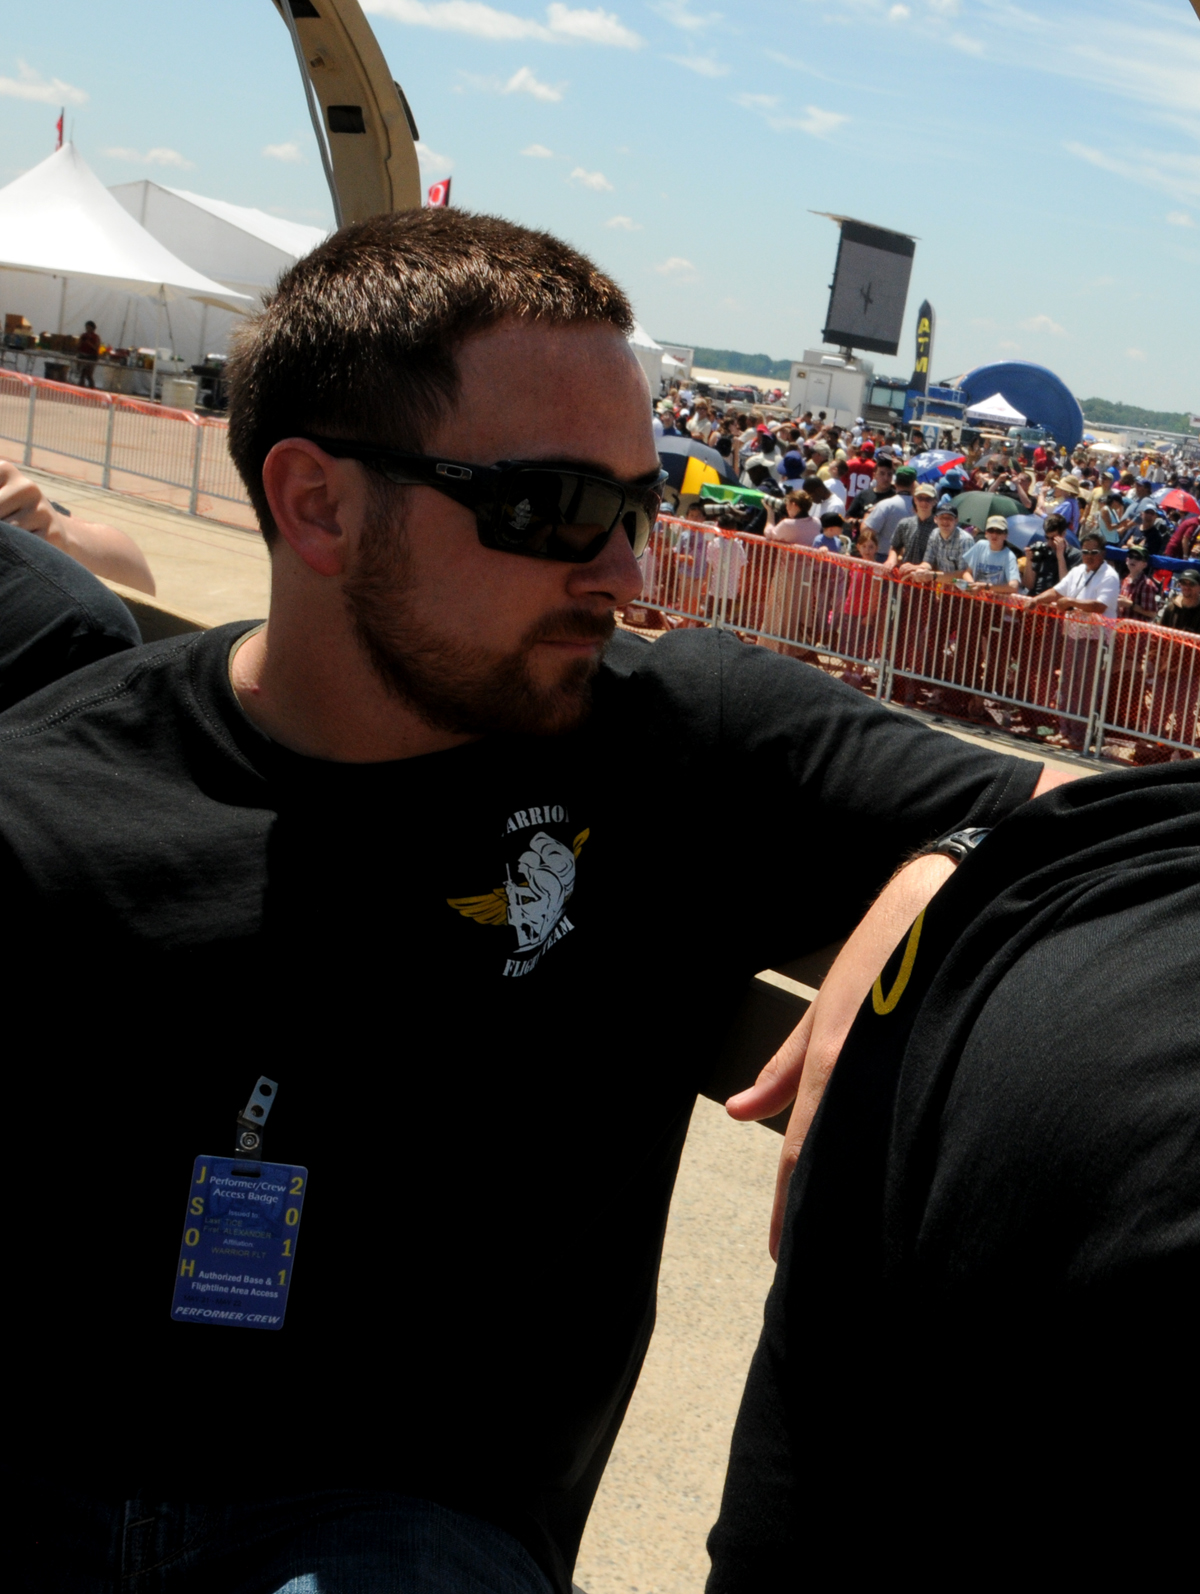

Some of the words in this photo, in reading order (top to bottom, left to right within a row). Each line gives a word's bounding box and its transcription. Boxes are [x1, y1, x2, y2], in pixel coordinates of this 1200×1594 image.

[915, 317, 930, 373] ATM
[848, 472, 871, 497] 19
[501, 804, 569, 837] ARRIO
[209, 1176, 287, 1192] Performer/Crew
[213, 1188, 245, 1200] Access
[248, 1191, 279, 1204] Badge
[228, 1209, 250, 1218] Issued
[223, 1228, 272, 1239] ALEXANDER
[211, 1247, 250, 1257] WARRIOR
[198, 1270, 242, 1283] Authorized
[243, 1275, 264, 1285] Base
[265, 1277, 272, 1286] &
[191, 1282, 228, 1293] Flightline
[230, 1286, 249, 1295] Area
[250, 1288, 279, 1298] Access
[174, 1306, 281, 1324] PERFORMER/CREW
